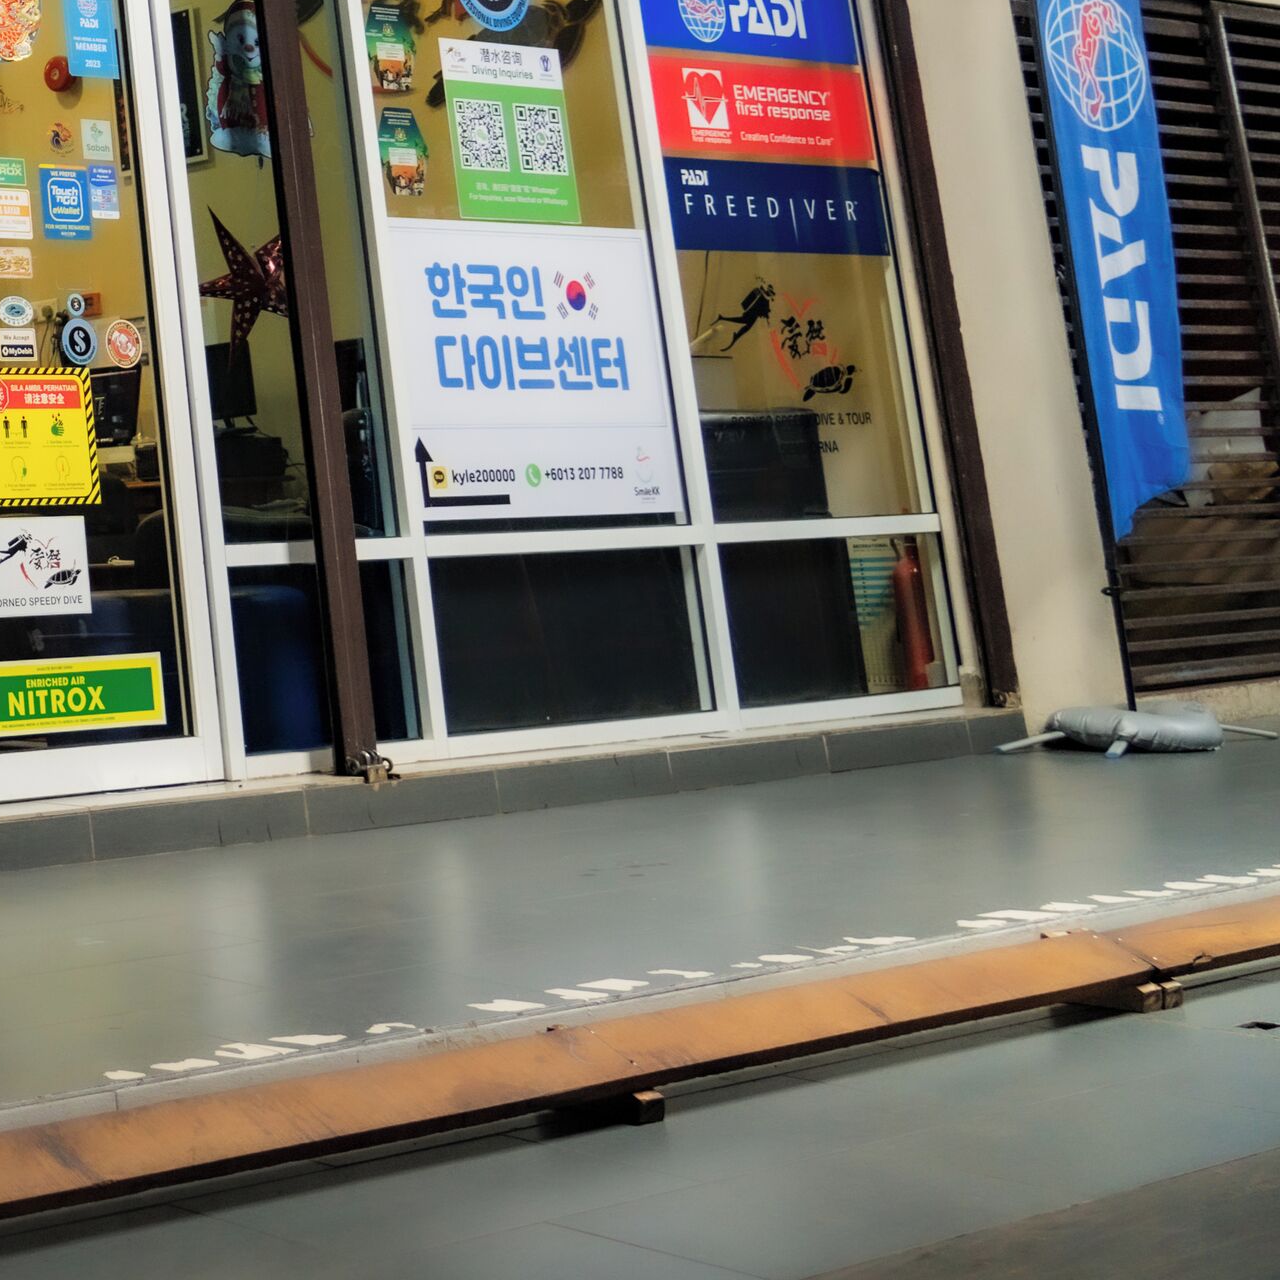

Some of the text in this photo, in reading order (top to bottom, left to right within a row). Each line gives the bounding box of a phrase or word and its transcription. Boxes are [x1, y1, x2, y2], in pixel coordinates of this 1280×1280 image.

[79, 17, 99, 29] PADI
[75, 42, 107, 53] MEMBER
[479, 47, 523, 67] 潜水咨询
[471, 65, 534, 81] Diving Inquiries
[733, 84, 828, 106] EMERGENCY
[735, 100, 831, 122] first response
[740, 131, 770, 146] Creating
[770, 133, 806, 146] Confidence
[807, 135, 816, 144] to
[86, 143, 110, 153] Sabah
[681, 168, 709, 187] PADI
[51, 186, 78, 197] Touch
[52, 207, 80, 216] eWallet
[684, 193, 857, 232] FREEDIVER
[1081, 145, 1163, 412] PADI
[424, 261, 546, 320] 한국인
[9, 347, 34, 356] MyDebit
[434, 333, 630, 391] 다이브센터
[26, 384, 78, 393] AMBIL PERHATIAN!
[24, 392, 66, 405] 请注意安全
[815, 411, 872, 425] DIVE TOUR
[452, 466, 624, 485] kyle200000 +6013 207 7788
[28, 595, 61, 607] SPEEDY
[62, 594, 84, 605] DIVE
[26, 675, 86, 689] ENRICHED AIR
[7, 686, 106, 717] NITROX
